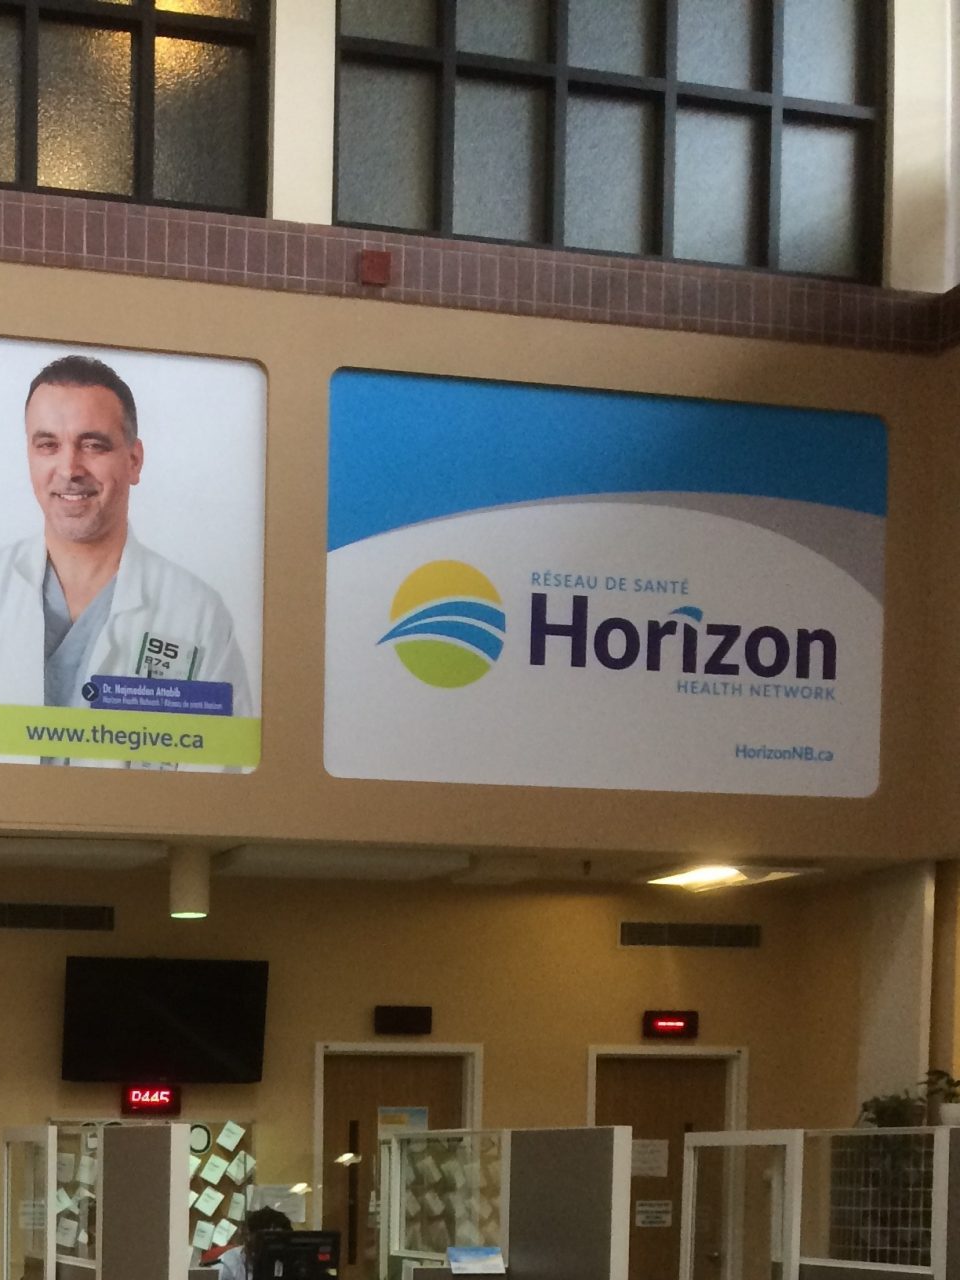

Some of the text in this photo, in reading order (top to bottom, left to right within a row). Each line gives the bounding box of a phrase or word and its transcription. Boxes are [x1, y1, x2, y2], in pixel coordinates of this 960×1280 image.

[531, 569, 689, 595] RÉSEAU DE SANTÉ
[529, 592, 837, 680] Horizon
[147, 637, 179, 659] 95
[102, 683, 113, 694] Dr.
[677, 680, 837, 701] HEALTH NETWORK
[26, 725, 204, 750] www.thegive.ca
[735, 743, 833, 762] HorizonNB.ca
